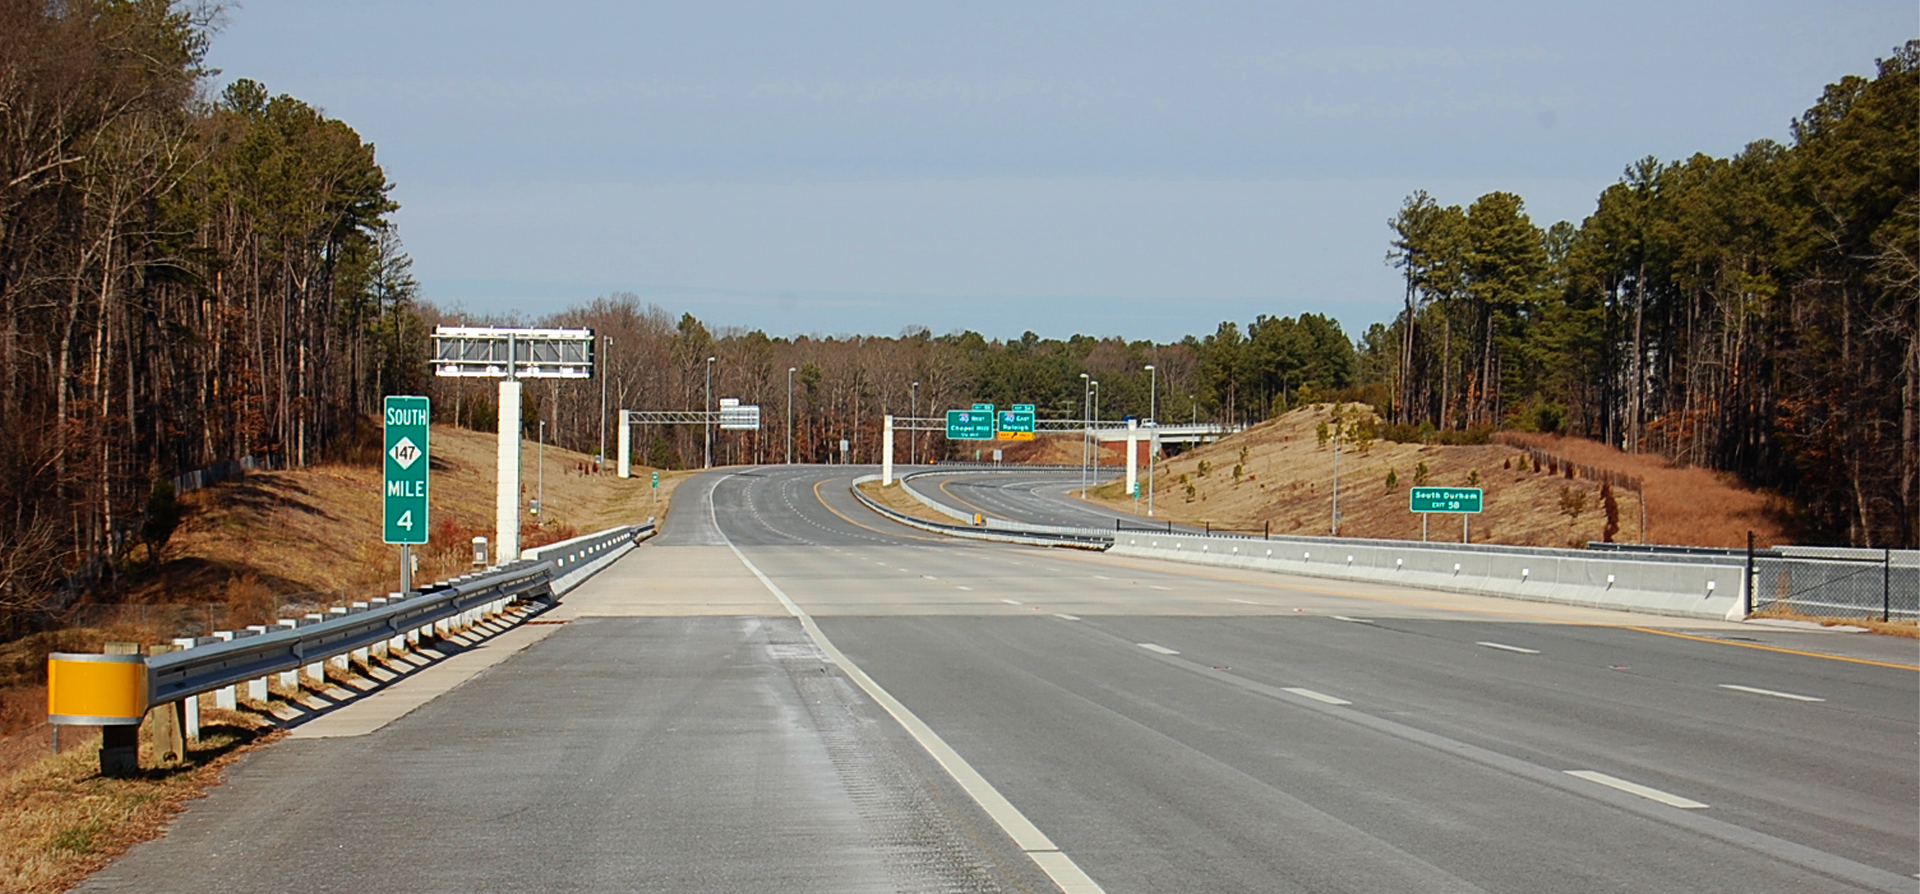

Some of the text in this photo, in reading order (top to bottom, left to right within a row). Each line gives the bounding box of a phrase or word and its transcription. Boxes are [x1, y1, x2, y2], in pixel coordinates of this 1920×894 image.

[387, 407, 427, 426] SOUTH
[395, 446, 416, 460] 147
[387, 480, 425, 497] MILE
[1415, 491, 1441, 499] South
[396, 509, 414, 532] 4
